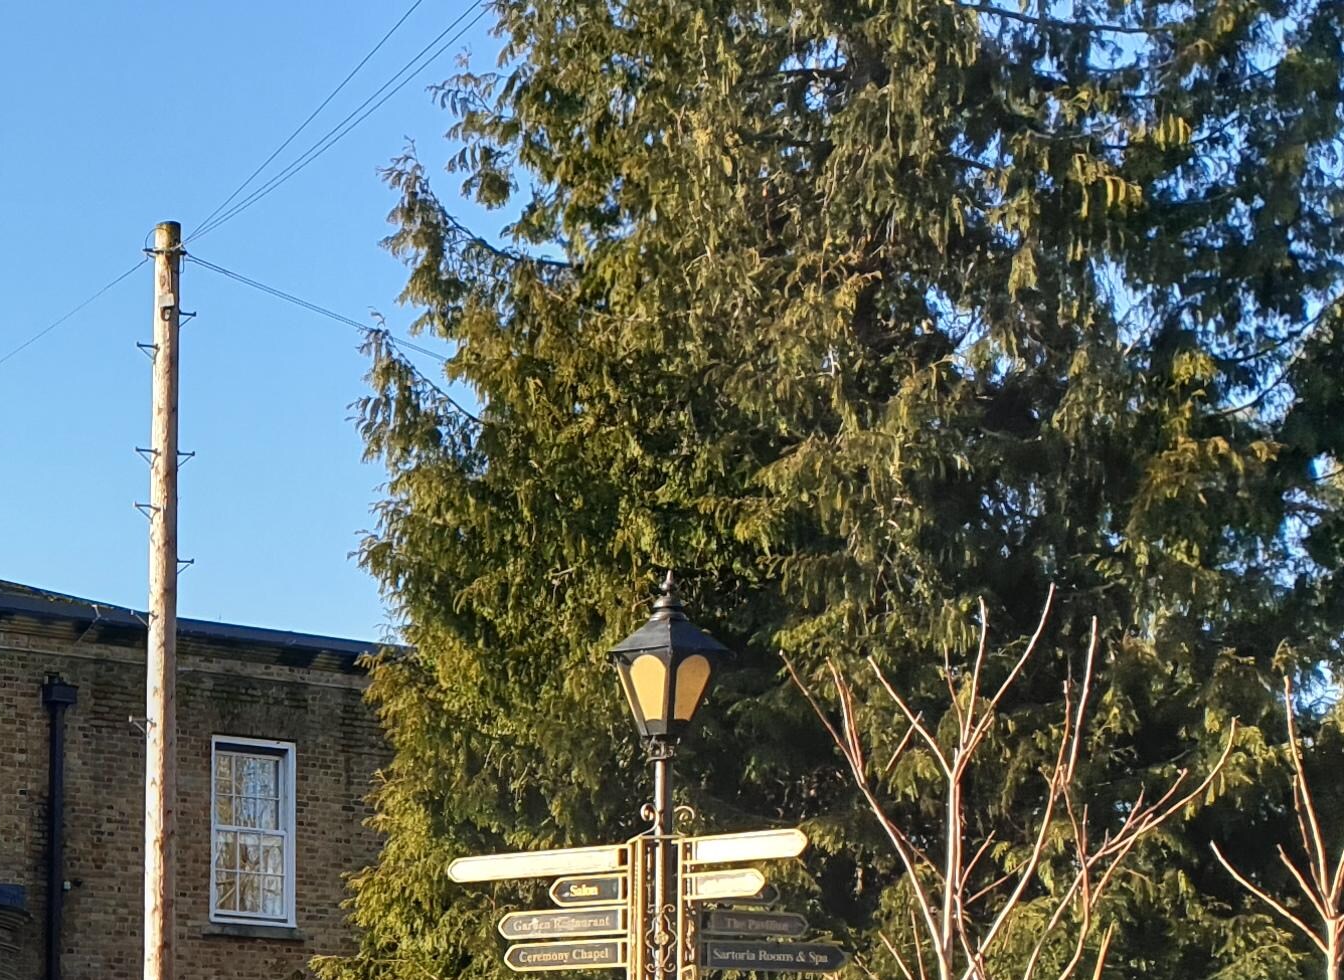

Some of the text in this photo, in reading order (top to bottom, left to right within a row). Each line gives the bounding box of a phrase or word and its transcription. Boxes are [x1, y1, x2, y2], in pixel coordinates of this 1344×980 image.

[569, 884, 599, 897] Salon
[513, 918, 551, 931] Garden
[519, 947, 609, 963] Ceremony Chapel
[713, 948, 829, 965] Sartoria Rooms & Spa
